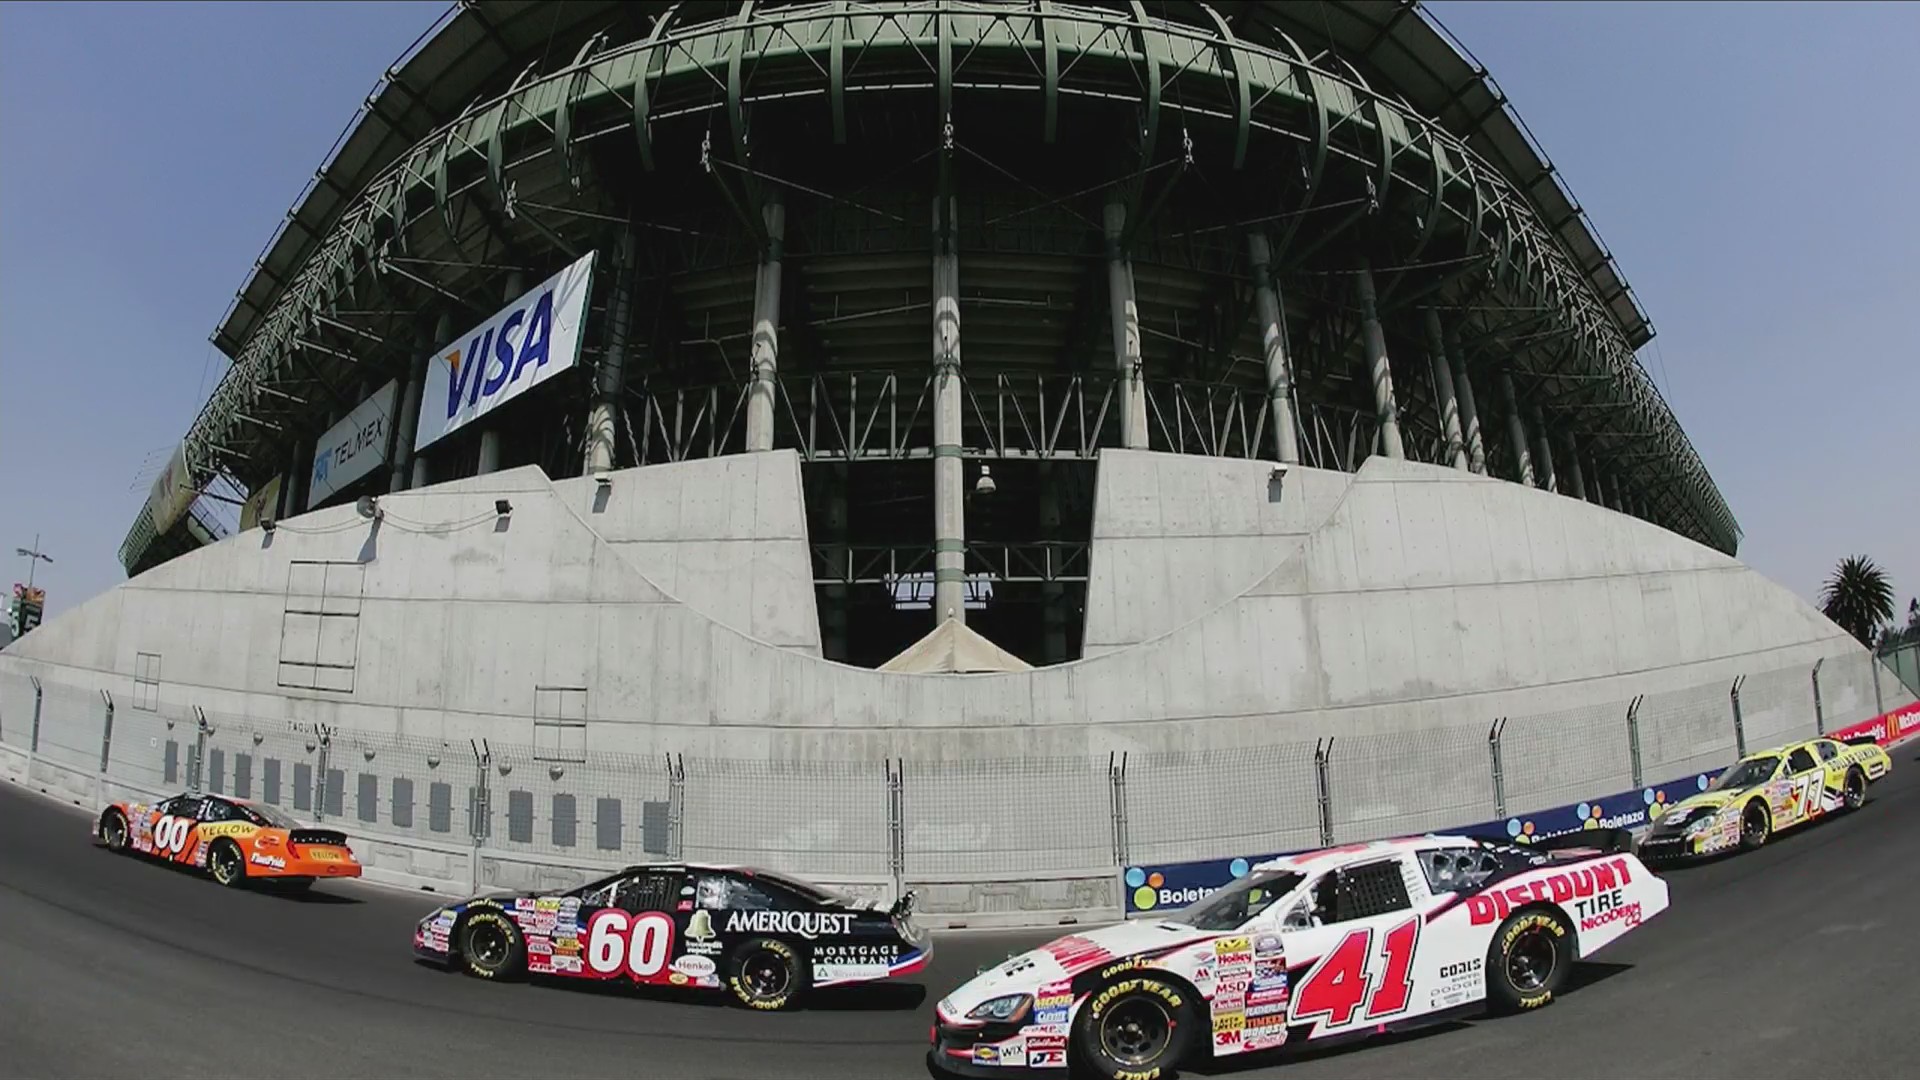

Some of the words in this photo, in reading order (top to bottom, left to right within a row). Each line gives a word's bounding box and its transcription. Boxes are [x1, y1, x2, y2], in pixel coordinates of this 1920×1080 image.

[446, 290, 554, 420] VISA
[334, 413, 385, 469] TELMEX
[1794, 768, 1823, 818] 77
[155, 815, 189, 853] 00
[201, 823, 254, 837] YELLOW
[1466, 857, 1632, 926] DISCOUNT
[1574, 889, 1624, 919] TIRE
[725, 911, 857, 939] AMERIQUEST
[1502, 914, 1565, 956] GOODYEAR
[588, 911, 671, 977] 60
[761, 941, 791, 958] EAGLE
[813, 944, 899, 957] MORTGAGE
[678, 961, 714, 972] Henkel
[823, 956, 899, 965] COMPANY
[1290, 914, 1421, 1027] 41
[1091, 977, 1183, 1016] GOODYEAR
[1215, 980, 1247, 995] MSD
[1001, 1044, 1023, 1058] WIX
[1215, 1030, 1241, 1046] 3M
[1032, 1051, 1064, 1065] JE
